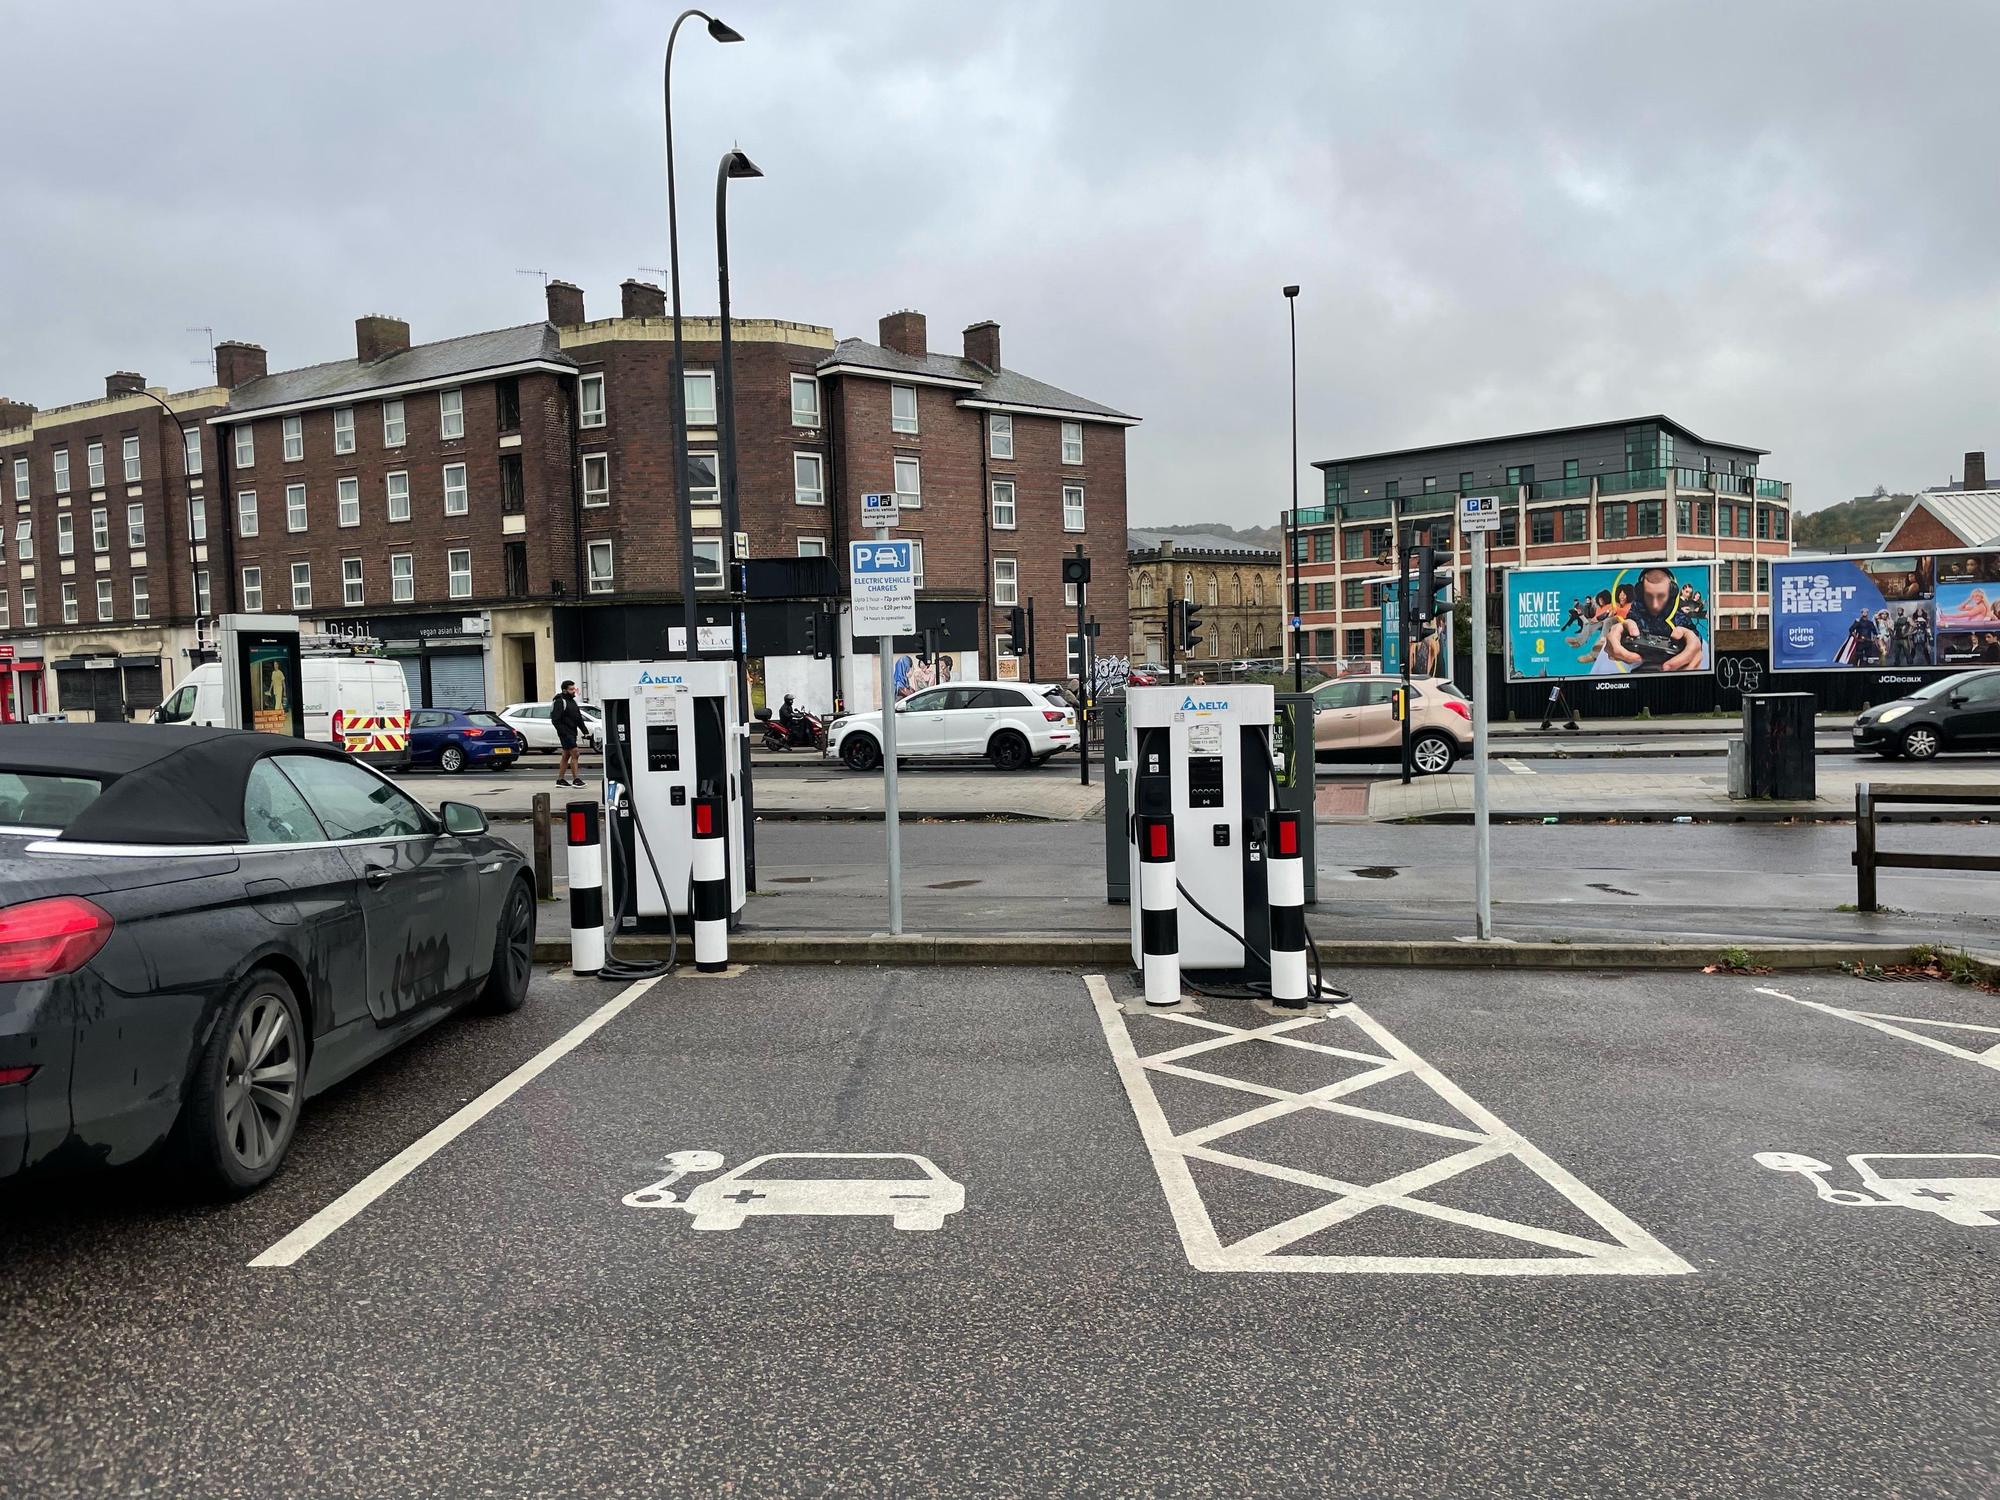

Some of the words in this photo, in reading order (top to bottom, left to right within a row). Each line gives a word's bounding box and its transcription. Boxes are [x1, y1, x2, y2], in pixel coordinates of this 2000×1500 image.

[857, 548, 872, 569] P
[884, 576, 911, 584] VEHICLE
[1781, 575, 1829, 589] IT'S
[1781, 586, 1857, 601] RIGHT
[1519, 592, 1544, 613] NEW
[1547, 591, 1560, 612] EE
[1781, 600, 1842, 613] HERE
[1519, 613, 1539, 628] DOES
[1540, 613, 1560, 627] MORE
[419, 629, 436, 637] vegan
[453, 626, 461, 634] kit
[1789, 627, 1814, 636] prime
[1789, 634, 1814, 642] video
[655, 676, 682, 684] DELTA
[1878, 675, 1922, 683] JCDecaux
[1595, 682, 1630, 690] JCDecaux
[1199, 701, 1228, 710] DELTA
